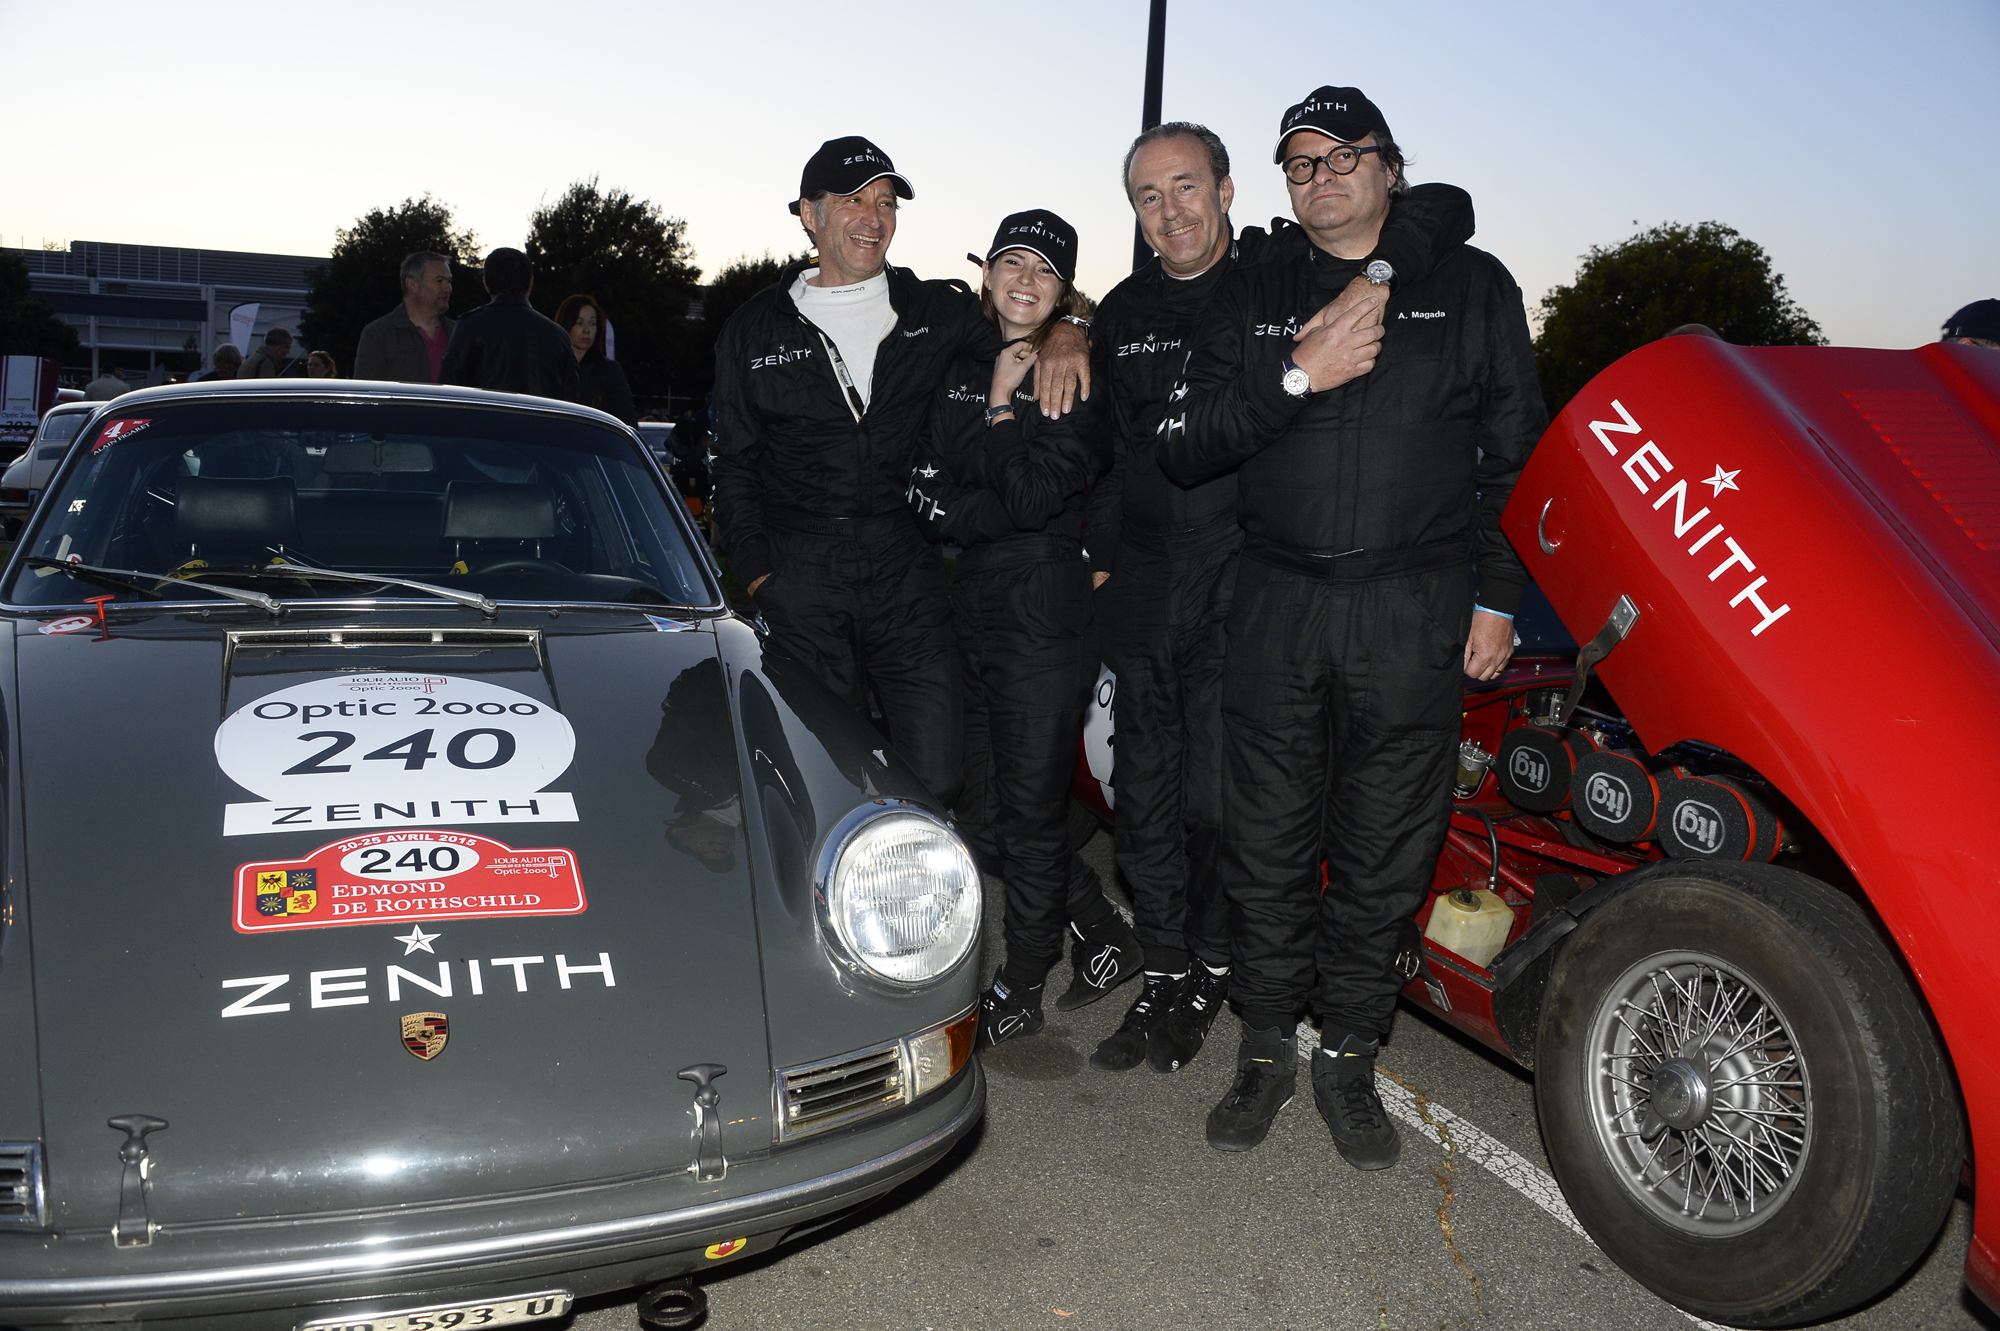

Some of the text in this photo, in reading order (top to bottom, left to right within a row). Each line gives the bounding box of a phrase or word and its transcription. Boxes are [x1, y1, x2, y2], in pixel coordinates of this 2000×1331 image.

[1287, 102, 1347, 128] ZENITH
[843, 154, 893, 172] ZENITH
[1009, 225, 1066, 247] ZENITH
[1397, 310, 1446, 320] A. Magada
[1117, 338, 1181, 356] ZENITH
[93, 422, 151, 456] ALAIN FIGARET
[104, 421, 125, 438] 4
[1588, 398, 1791, 637] ZENITH
[253, 697, 540, 724] Optic 2000
[281, 728, 516, 776] 240
[1514, 750, 1544, 788] itg
[1591, 776, 1625, 819] itg
[271, 799, 540, 825] ZENITH
[1679, 805, 1717, 849] itg
[337, 833, 477, 853] 20-25 AVRIL 2015
[360, 846, 460, 874] 240
[494, 867, 548, 876] Optic 2000
[520, 856, 546, 864] AUTO
[331, 881, 446, 899] EDMOND
[332, 892, 541, 916] DE ROTHSCHILD
[221, 951, 616, 1018] ZENITH
[408, 1295, 555, 1331] 593 U
